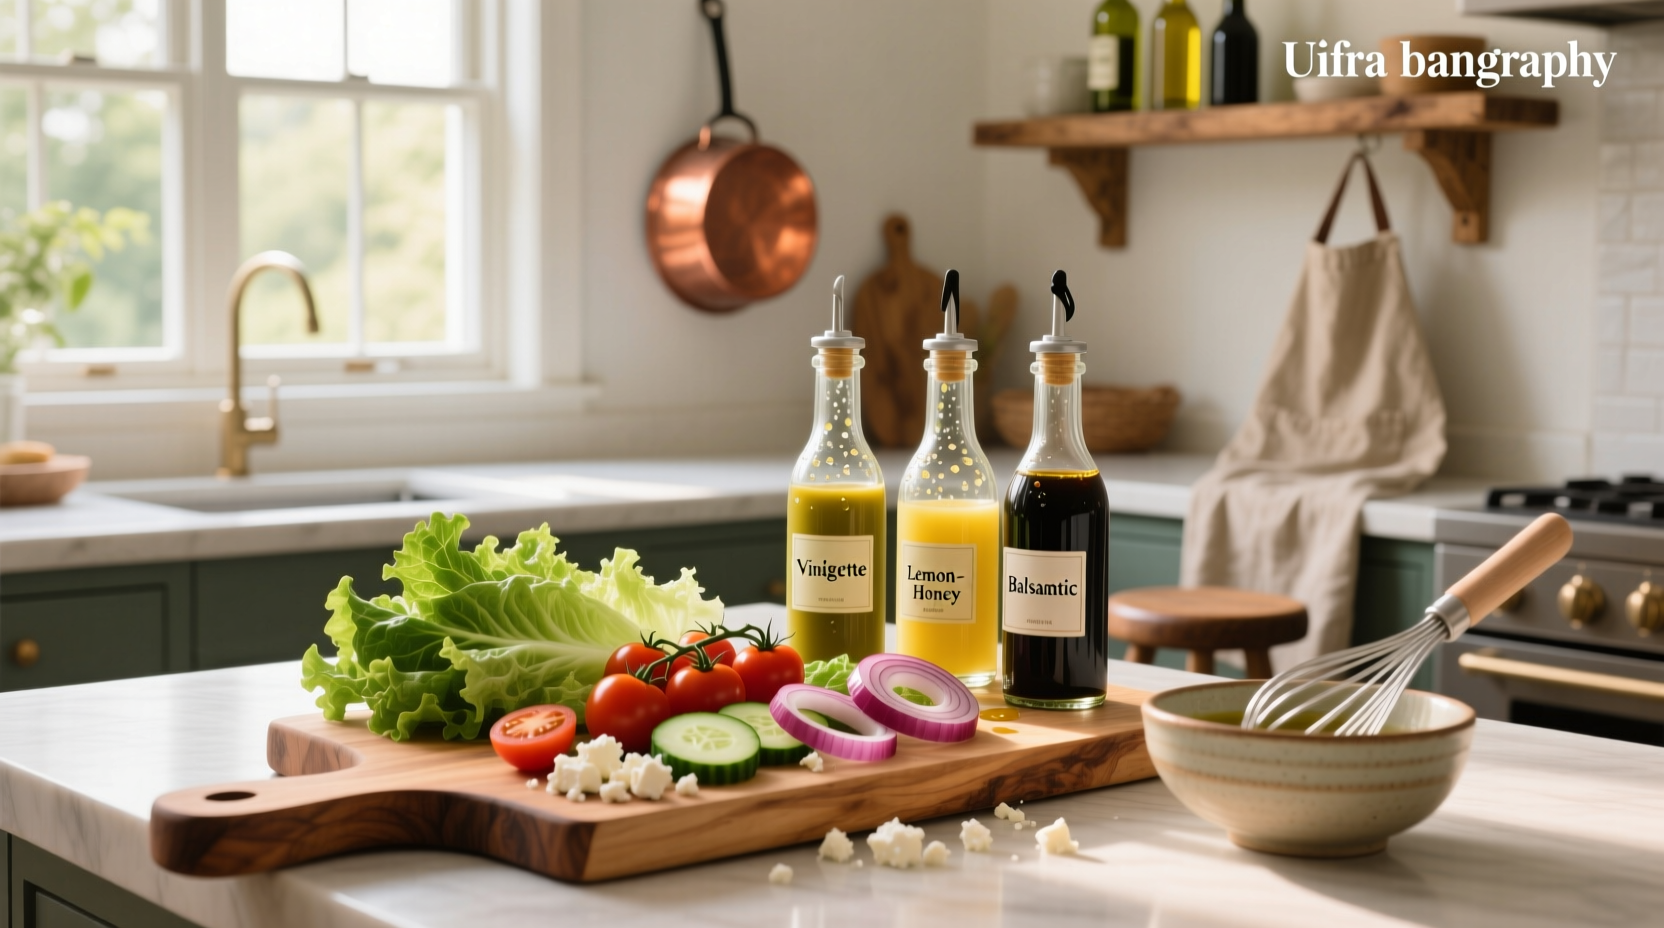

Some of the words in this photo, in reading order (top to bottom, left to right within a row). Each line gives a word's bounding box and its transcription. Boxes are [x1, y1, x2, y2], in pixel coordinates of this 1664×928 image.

[797, 558, 867, 582] Vinigette
[907, 565, 965, 583] Lemon-
[913, 584, 961, 606] Honey
[1008, 575, 1078, 596] Balsamtic
